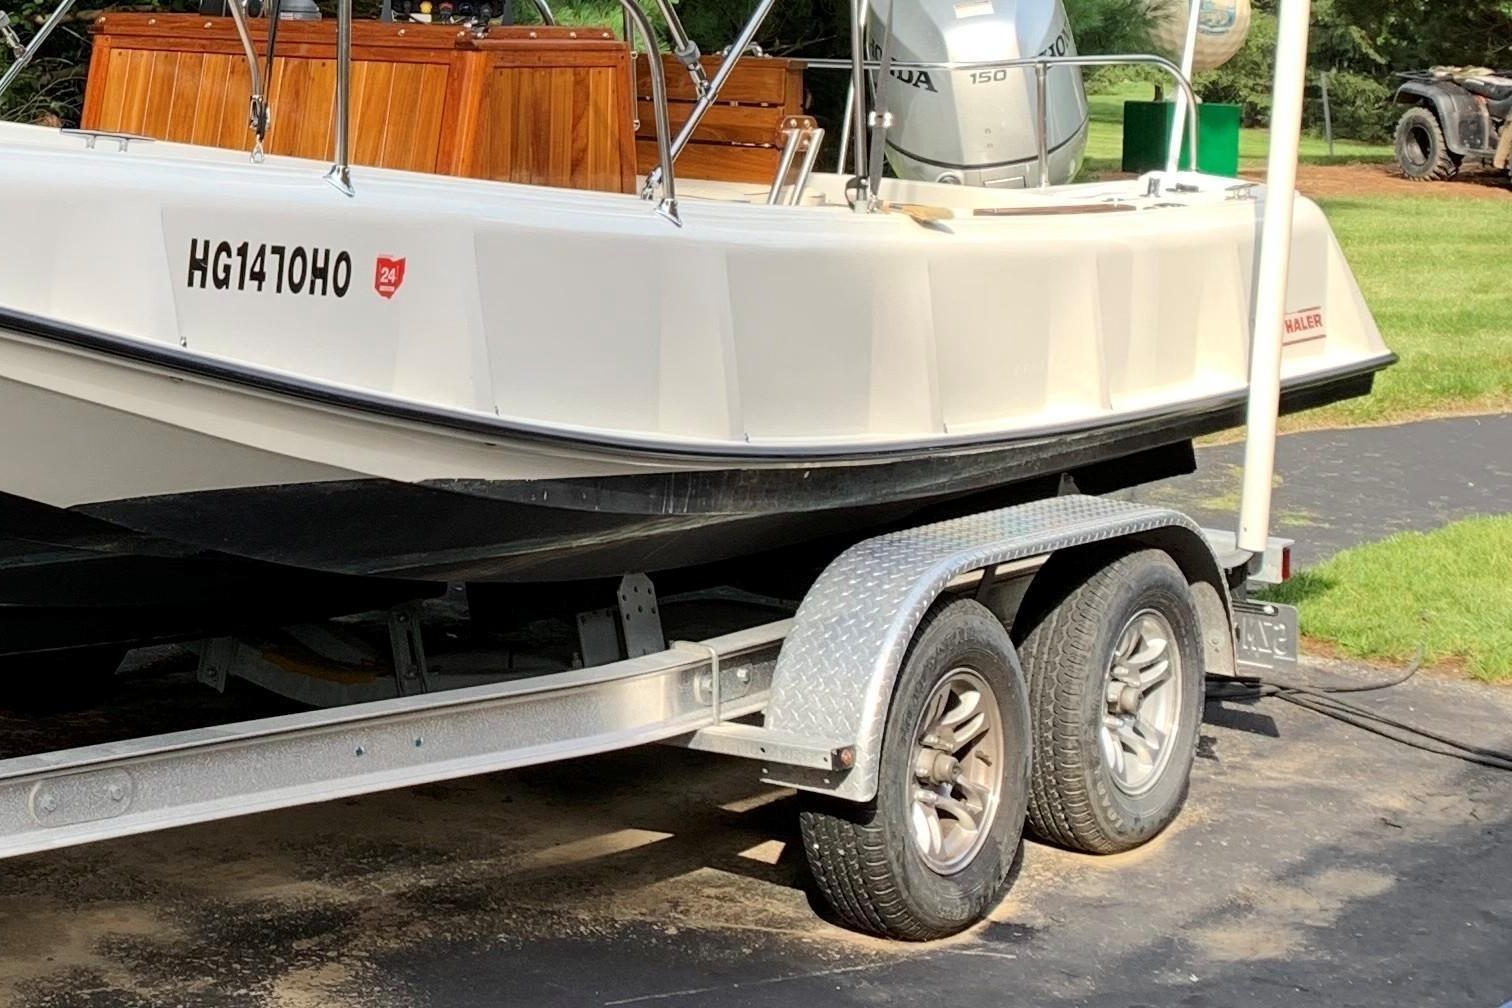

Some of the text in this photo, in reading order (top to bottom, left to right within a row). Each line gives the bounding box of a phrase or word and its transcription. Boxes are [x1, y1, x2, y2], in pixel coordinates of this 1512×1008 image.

[968, 69, 1008, 86] 150
[379, 266, 396, 284] 24
[1284, 313, 1324, 334] HALER
